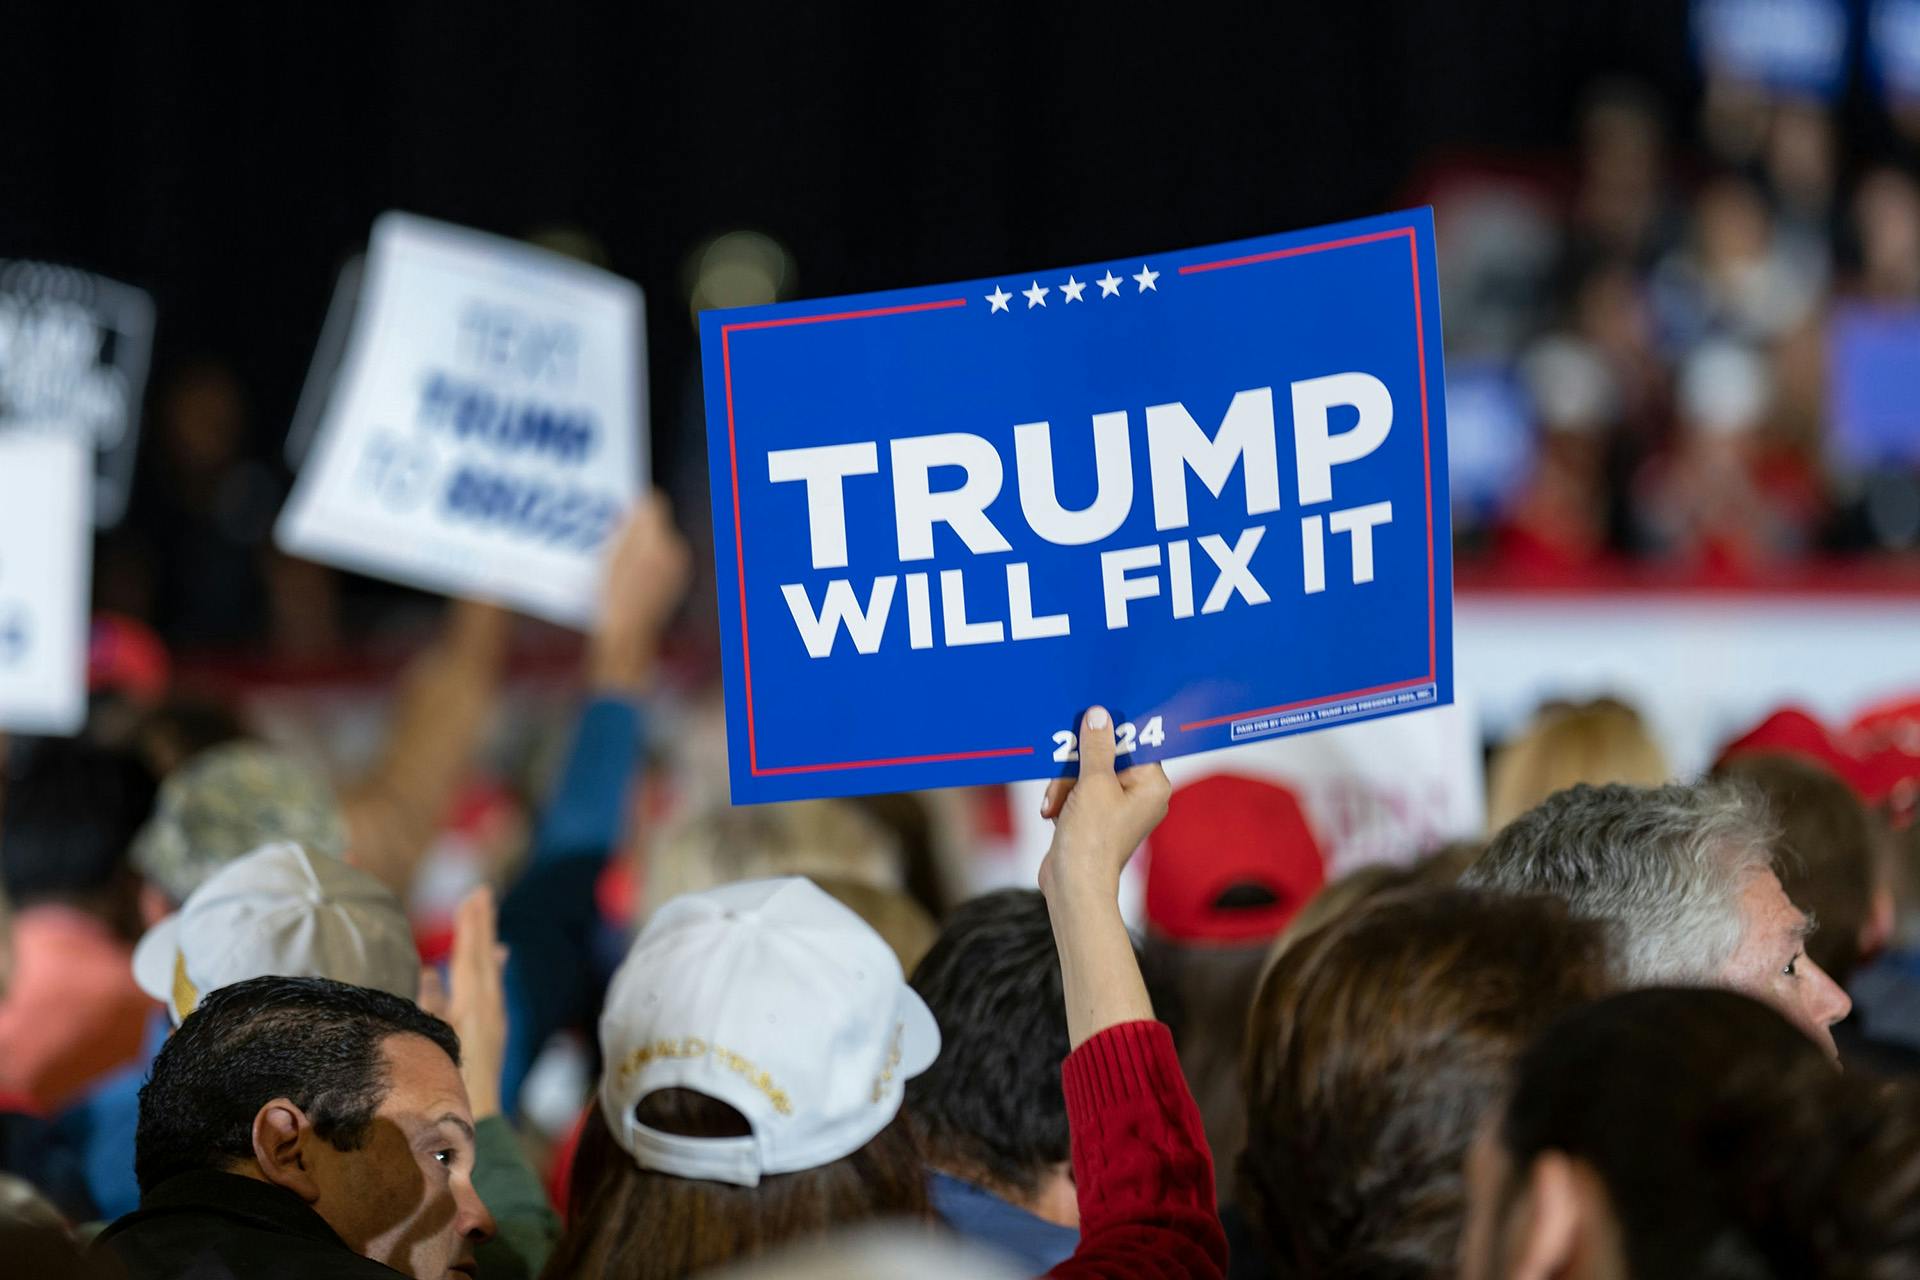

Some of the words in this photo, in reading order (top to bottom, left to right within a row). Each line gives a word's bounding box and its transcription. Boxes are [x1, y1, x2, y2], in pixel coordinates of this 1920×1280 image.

[767, 372, 1394, 570] TRUMP
[780, 562, 1071, 658] WILL
[1100, 526, 1271, 630] FIX
[1301, 501, 1393, 594] IT
[1052, 715, 1166, 763] 224
[1236, 722, 1254, 735] PAID
[1254, 719, 1270, 732] FOR
[1270, 718, 1279, 729] BY
[1280, 711, 1311, 727] DONALD
[1318, 705, 1342, 718] TRUMP
[1343, 703, 1358, 715] FOR
[1359, 695, 1397, 711] PRESIDENT
